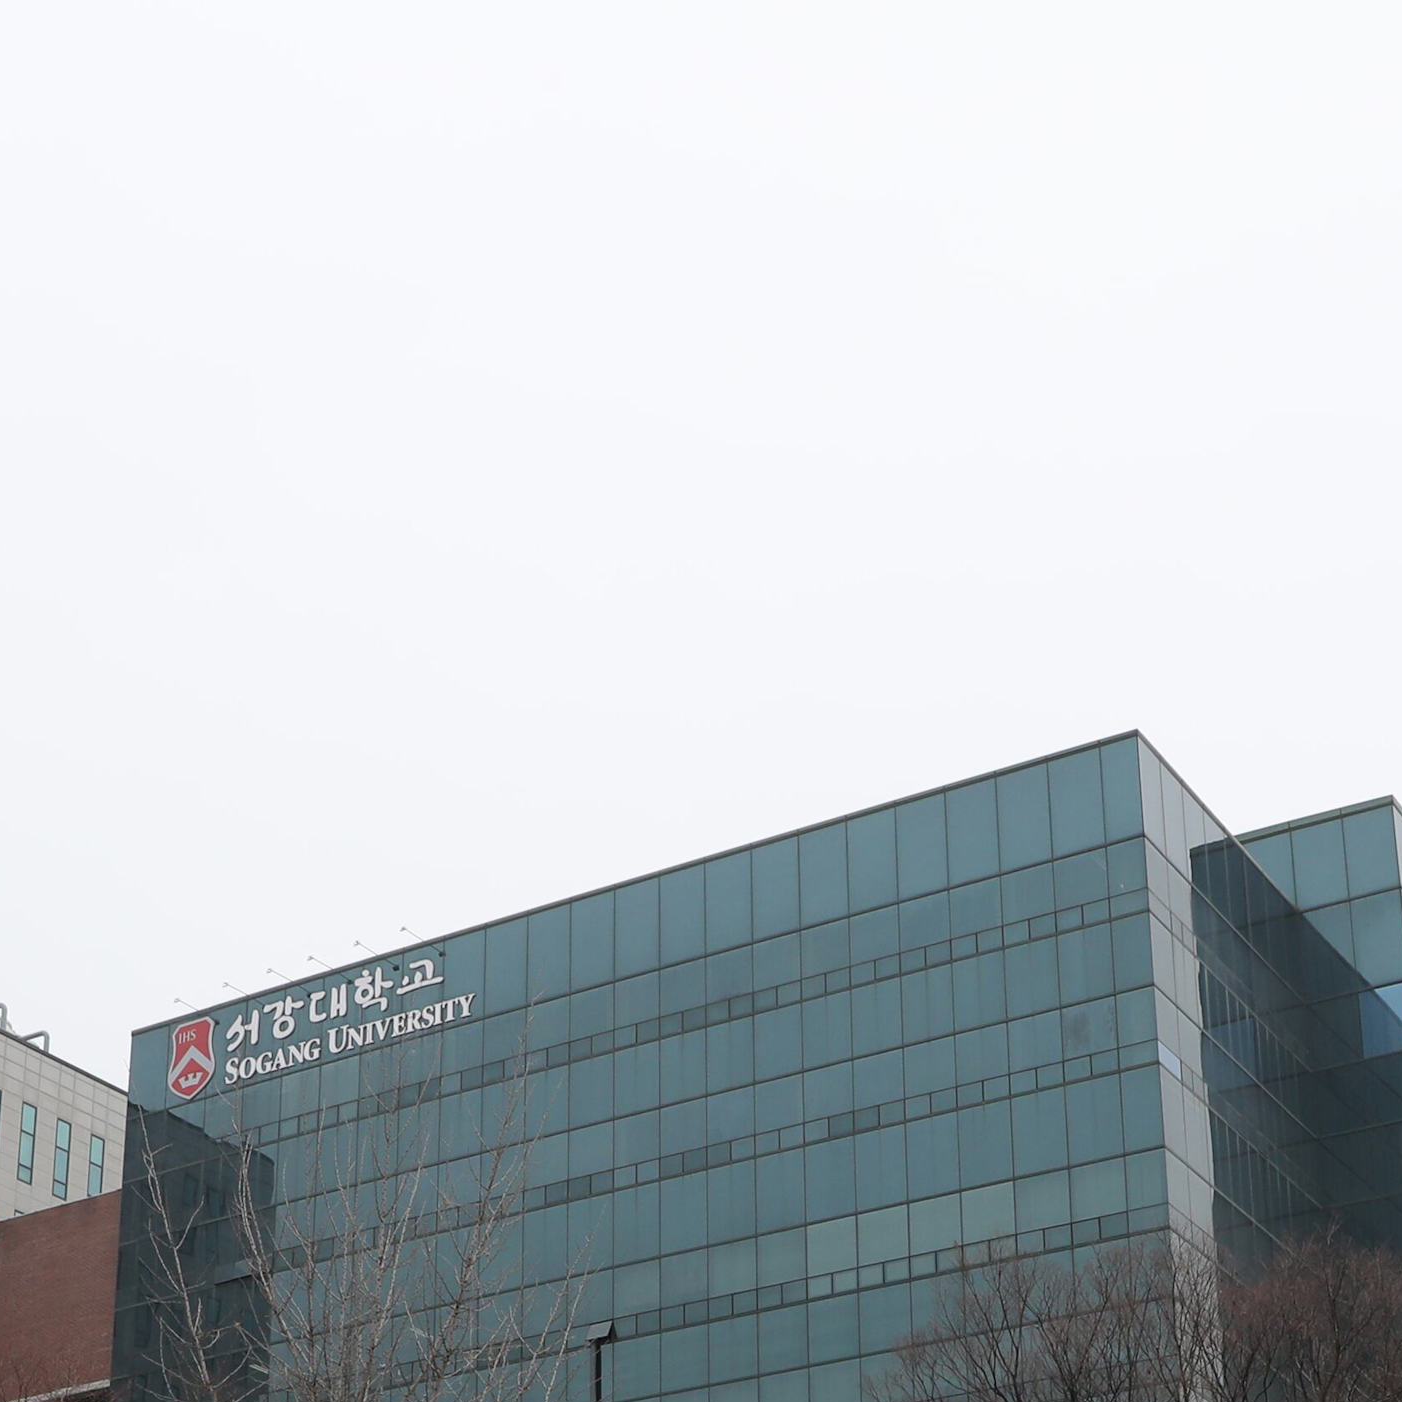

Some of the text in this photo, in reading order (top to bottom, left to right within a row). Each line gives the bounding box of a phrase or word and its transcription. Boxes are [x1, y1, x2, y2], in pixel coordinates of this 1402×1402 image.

[179, 1028, 197, 1045] IHS
[224, 993, 476, 1084] SOGANG UNIVERSITY
[225, 958, 444, 1051] 서강대학교
